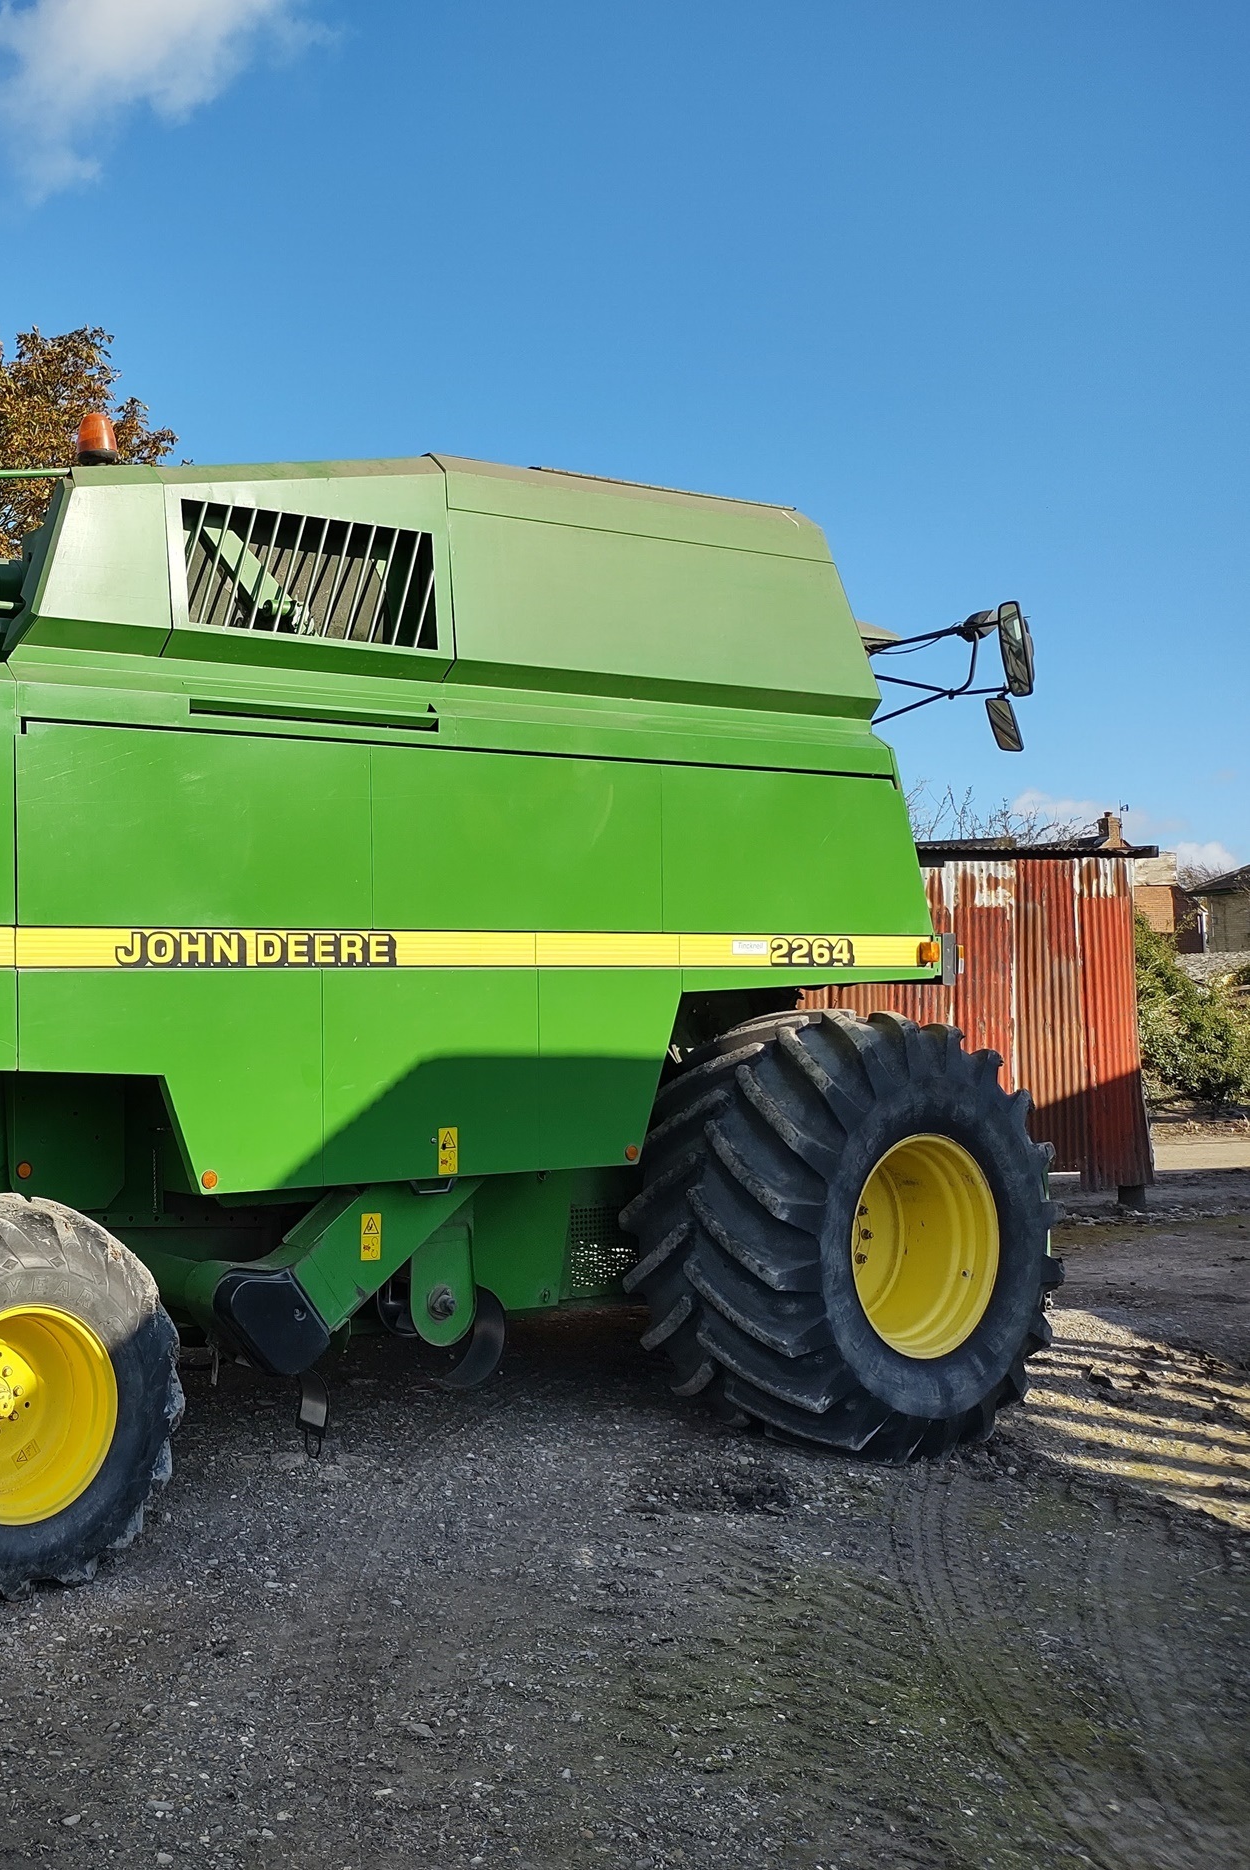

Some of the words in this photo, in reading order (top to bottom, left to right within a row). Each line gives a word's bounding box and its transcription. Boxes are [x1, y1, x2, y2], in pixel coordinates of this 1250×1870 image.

[115, 931, 247, 966] JOHN
[255, 932, 397, 967] DEERE
[771, 937, 855, 967] 2264
